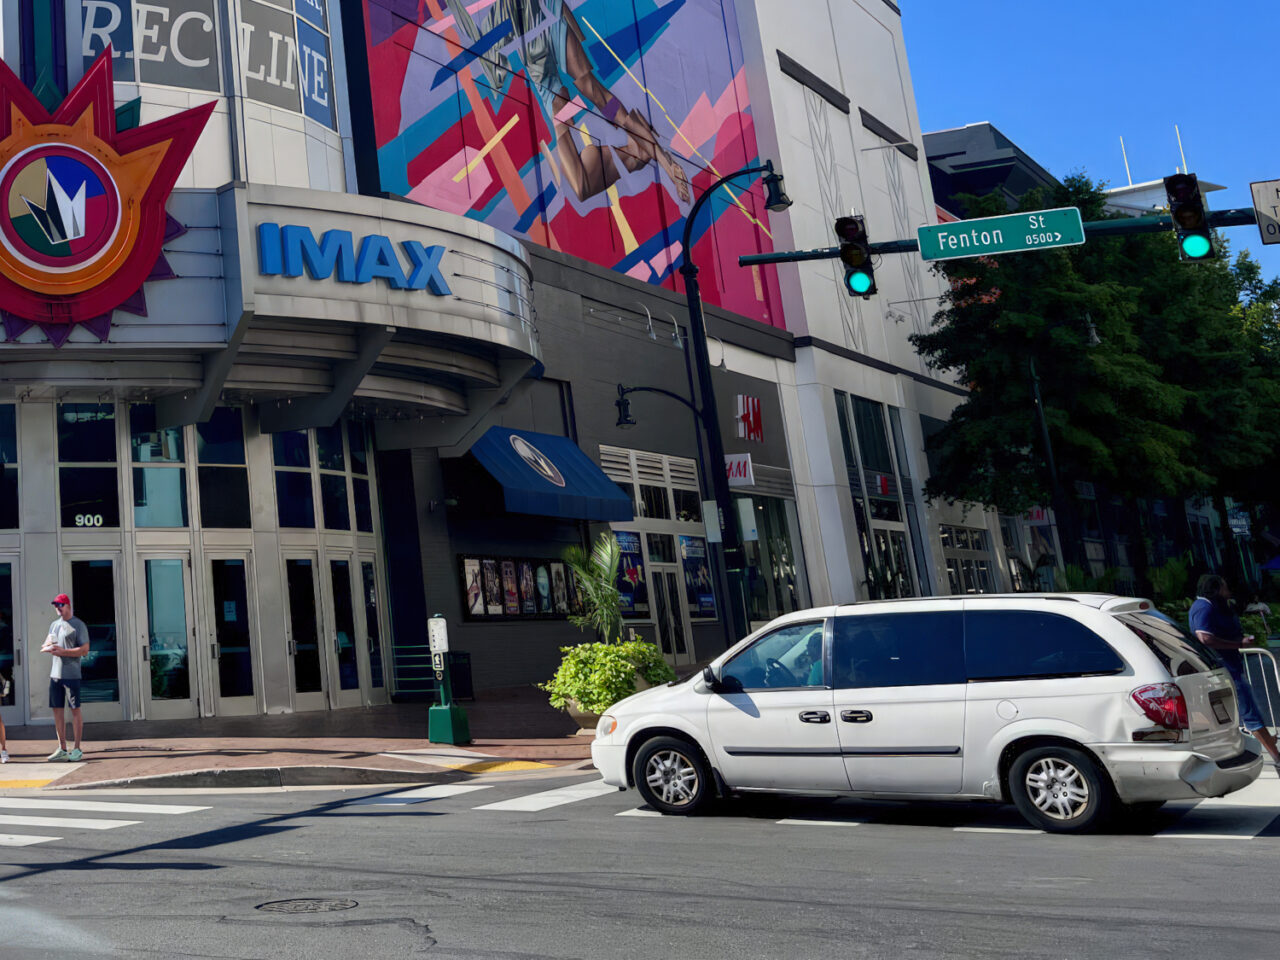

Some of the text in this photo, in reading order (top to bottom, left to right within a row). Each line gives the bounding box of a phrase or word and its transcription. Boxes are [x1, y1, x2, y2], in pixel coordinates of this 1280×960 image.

[1028, 215, 1046, 229] St
[937, 229, 1053, 250] Fenton 0500
[257, 222, 452, 296] IMAX
[75, 514, 103, 527] 900
